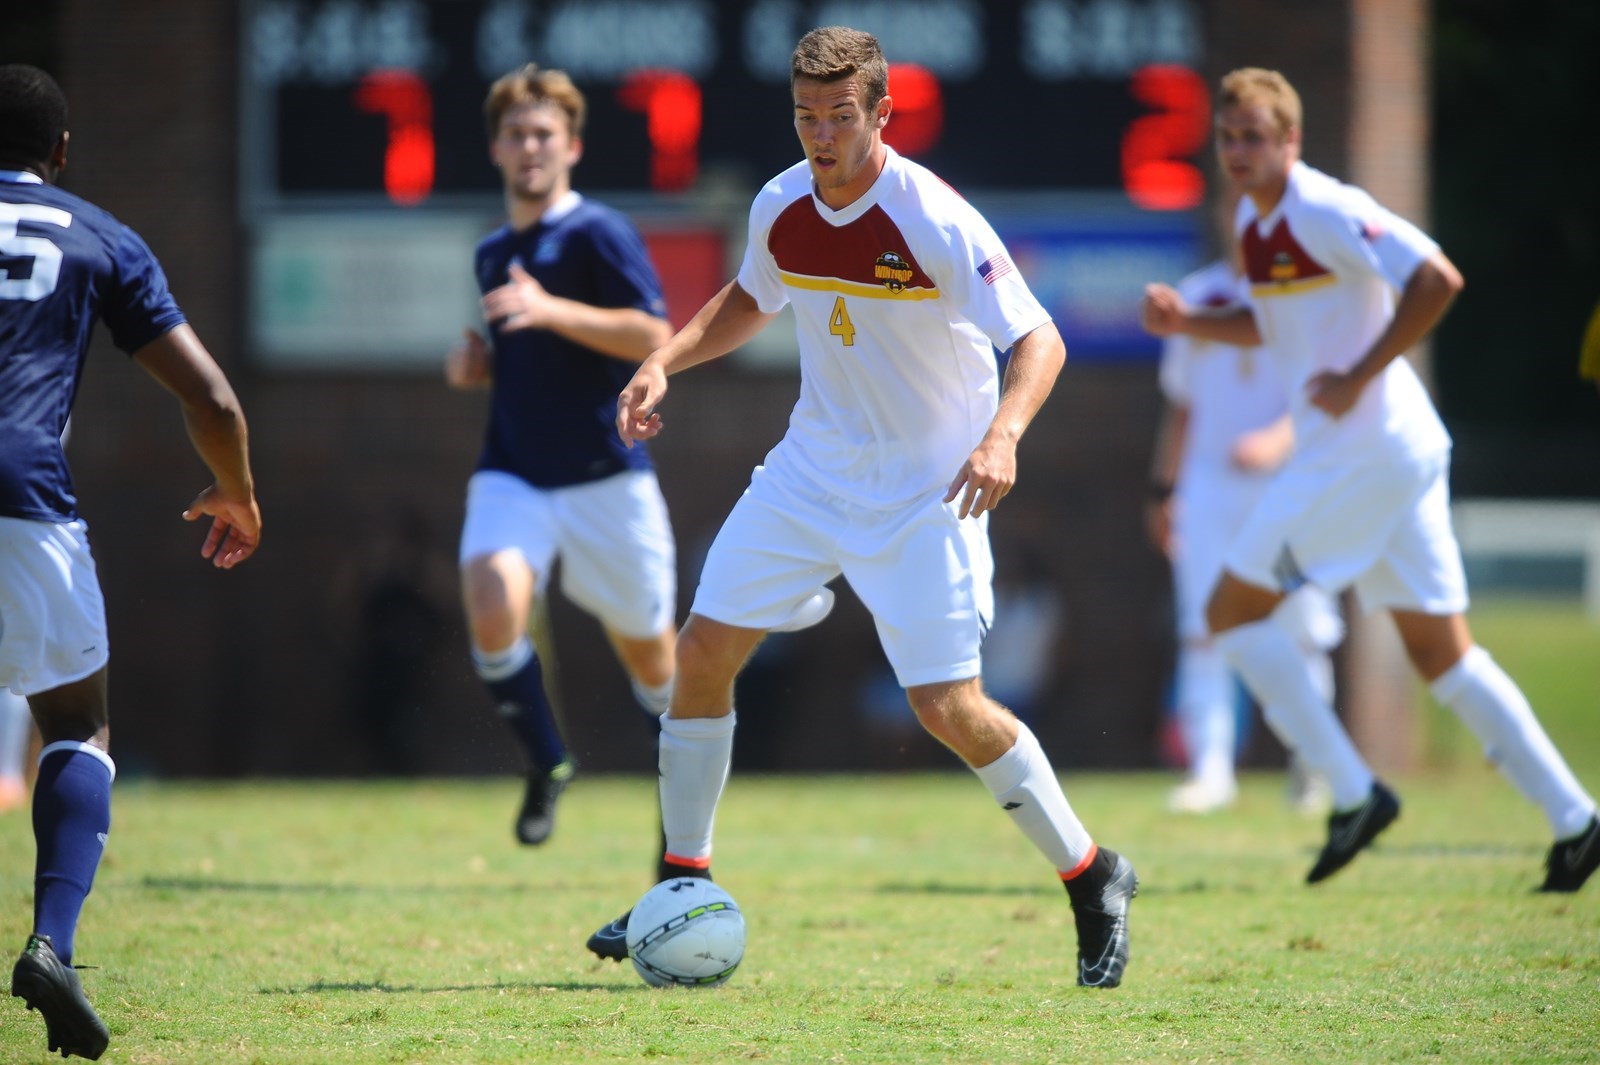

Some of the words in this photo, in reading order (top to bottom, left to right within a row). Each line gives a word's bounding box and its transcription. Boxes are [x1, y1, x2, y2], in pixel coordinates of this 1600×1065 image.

[1121, 64, 1211, 210] 2
[0, 202, 72, 302] 5
[829, 296, 856, 346] 4
